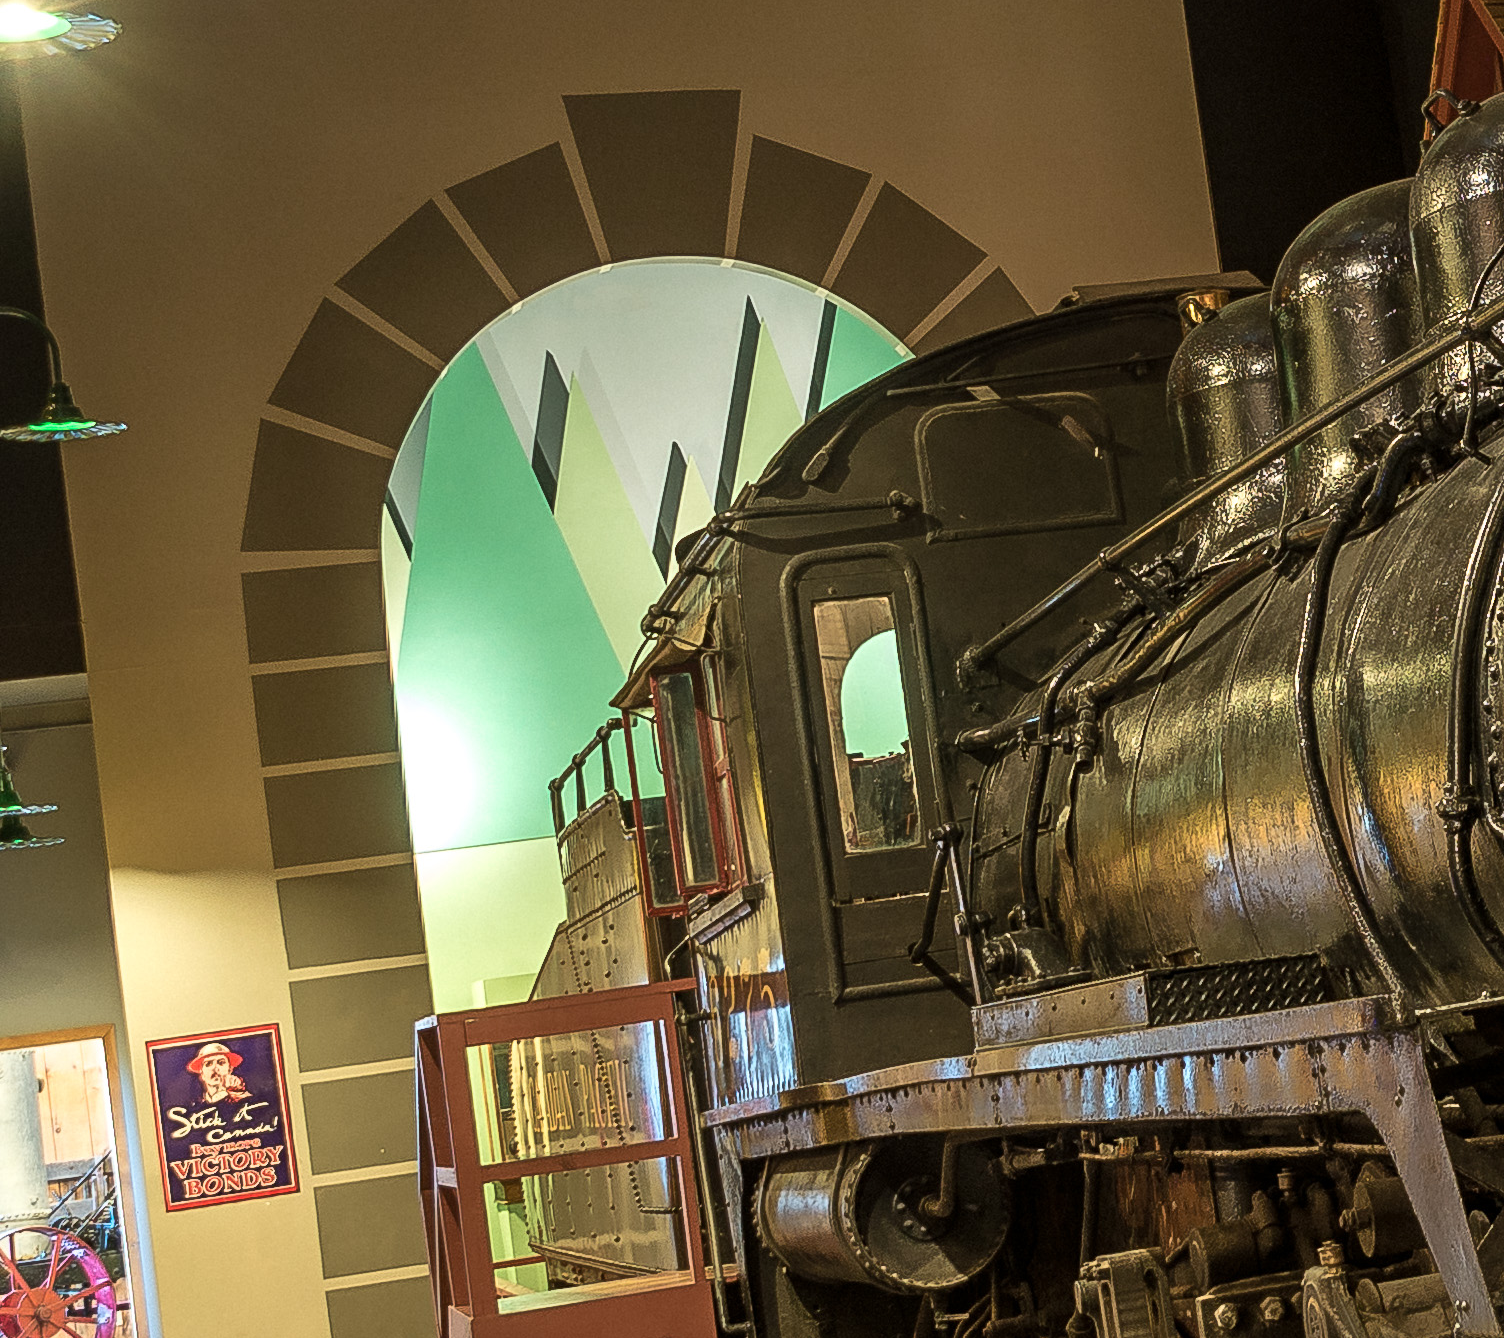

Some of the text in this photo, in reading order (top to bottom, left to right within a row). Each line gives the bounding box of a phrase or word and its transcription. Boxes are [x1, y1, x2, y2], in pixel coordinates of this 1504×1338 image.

[167, 1102, 270, 1139] Stick it
[206, 1116, 278, 1143] Canada!
[170, 1145, 284, 1179] VICTORY
[190, 1138, 261, 1157] Buy more
[184, 1167, 277, 1198] BONDS
